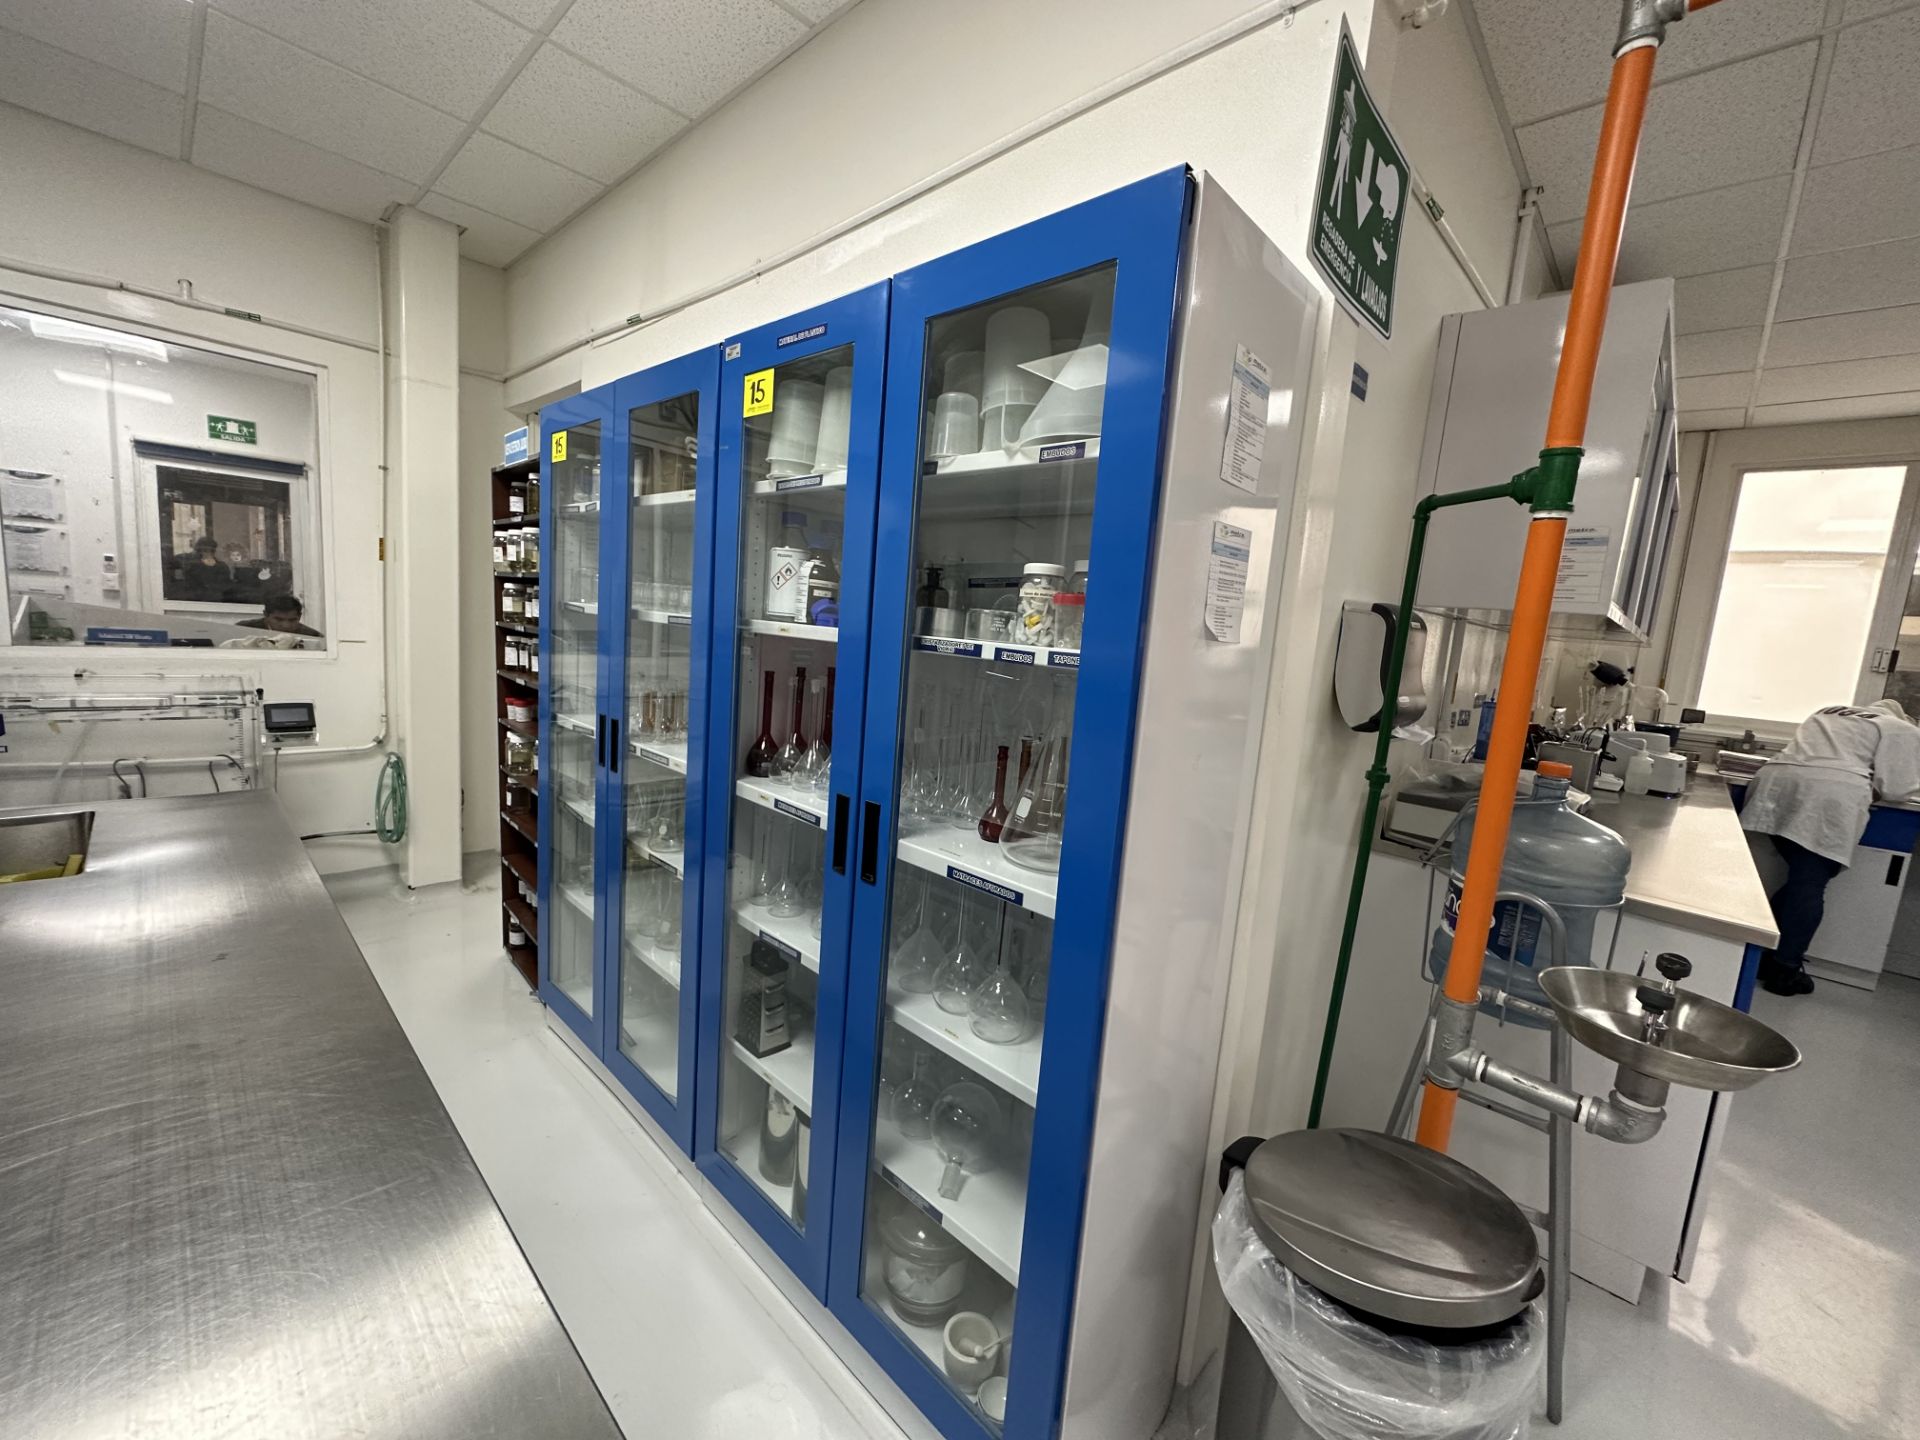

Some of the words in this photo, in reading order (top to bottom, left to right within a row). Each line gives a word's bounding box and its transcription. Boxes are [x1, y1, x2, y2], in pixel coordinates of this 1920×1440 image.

[1322, 210, 1348, 260] REGADERA
[1347, 250, 1356, 270] DE
[1320, 232, 1351, 286] EMERGENCIA
[1355, 263, 1363, 294] Y
[1361, 270, 1388, 322] LAVAOJOS
[750, 378, 766, 405] 15
[220, 433, 246, 442] SALIDA
[555, 436, 563, 454] 15
[1041, 446, 1076, 459] EMBUDOS
[1001, 651, 1033, 663] EMBUDOS
